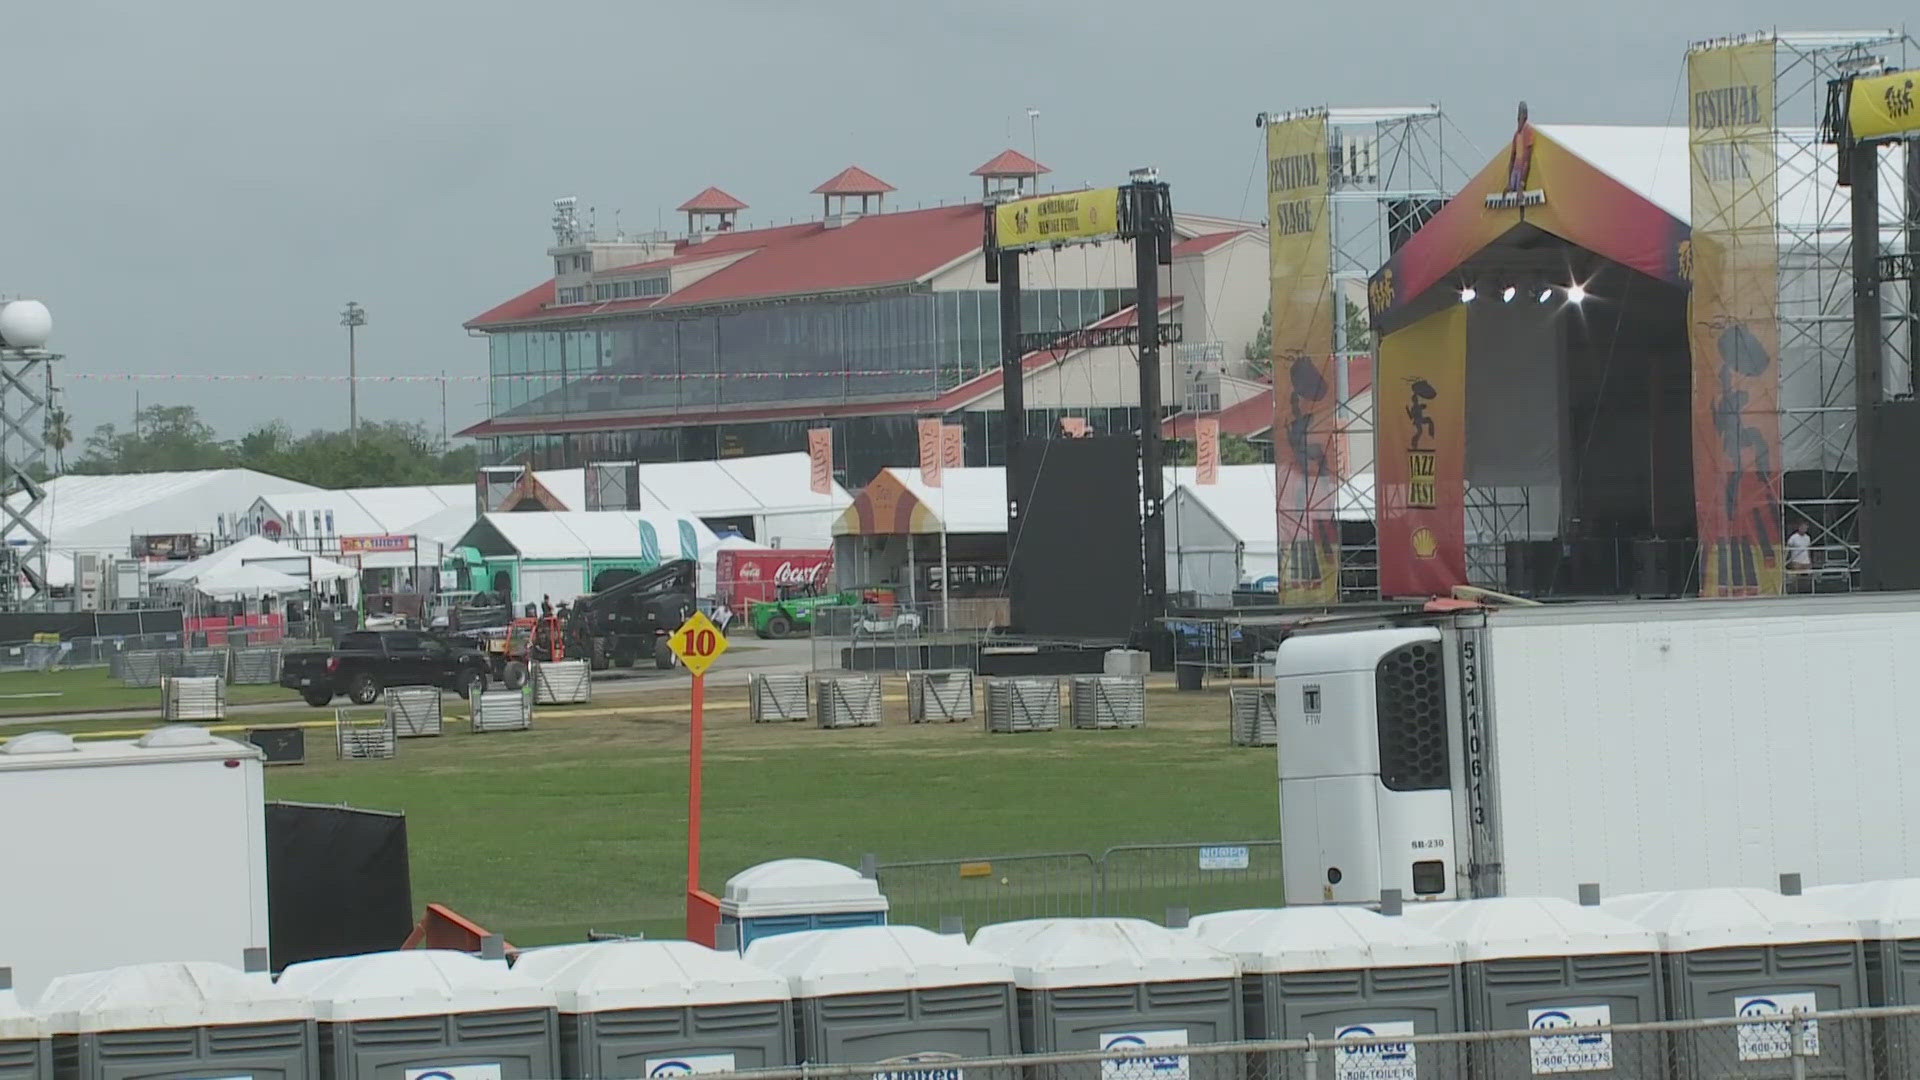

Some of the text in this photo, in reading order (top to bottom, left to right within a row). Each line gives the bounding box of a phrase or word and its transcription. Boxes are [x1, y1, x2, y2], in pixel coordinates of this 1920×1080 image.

[1695, 85, 1761, 131] FESTIVAL
[1270, 152, 1320, 193] FESTIVAL
[1277, 199, 1313, 236] STAGE
[1410, 455, 1434, 479] JAZZ
[1410, 483, 1434, 503] FEST
[682, 629, 716, 657] 10
